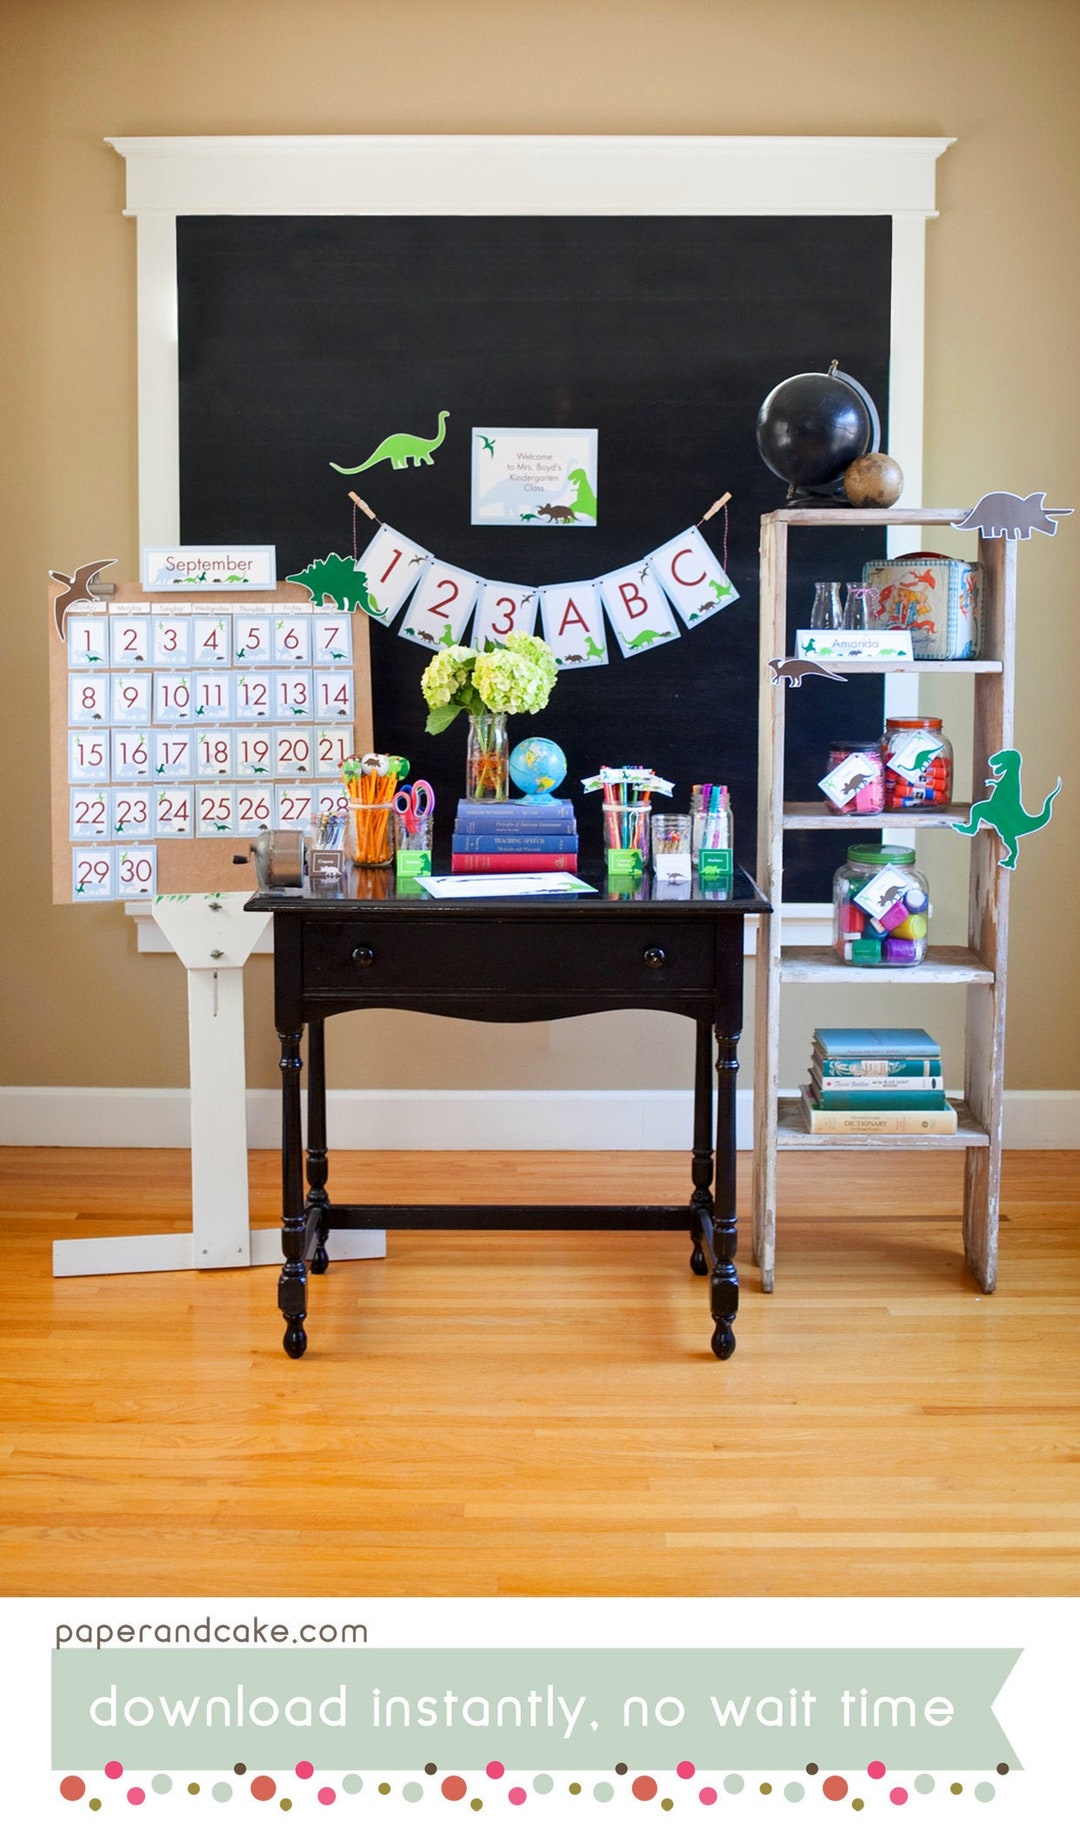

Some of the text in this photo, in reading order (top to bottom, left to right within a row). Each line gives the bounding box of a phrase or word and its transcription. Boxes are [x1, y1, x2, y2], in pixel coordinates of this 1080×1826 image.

[536, 464, 561, 472] Boyd's
[166, 554, 254, 576] September
[380, 549, 706, 636] 1 2 3 A B C
[84, 628, 339, 651] 1 2 3 4 5 6 7
[832, 638, 879, 648] Amanda
[82, 683, 349, 709] 8 9 10 11 12 13 14
[78, 739, 344, 765] 15 16 17 18 19 20 21
[75, 802, 105, 823] 22
[118, 801, 147, 822] 23
[159, 799, 189, 821] 24
[201, 798, 230, 820] 25
[239, 798, 269, 819] 26
[281, 798, 311, 820] 27
[78, 859, 152, 883] 29 30
